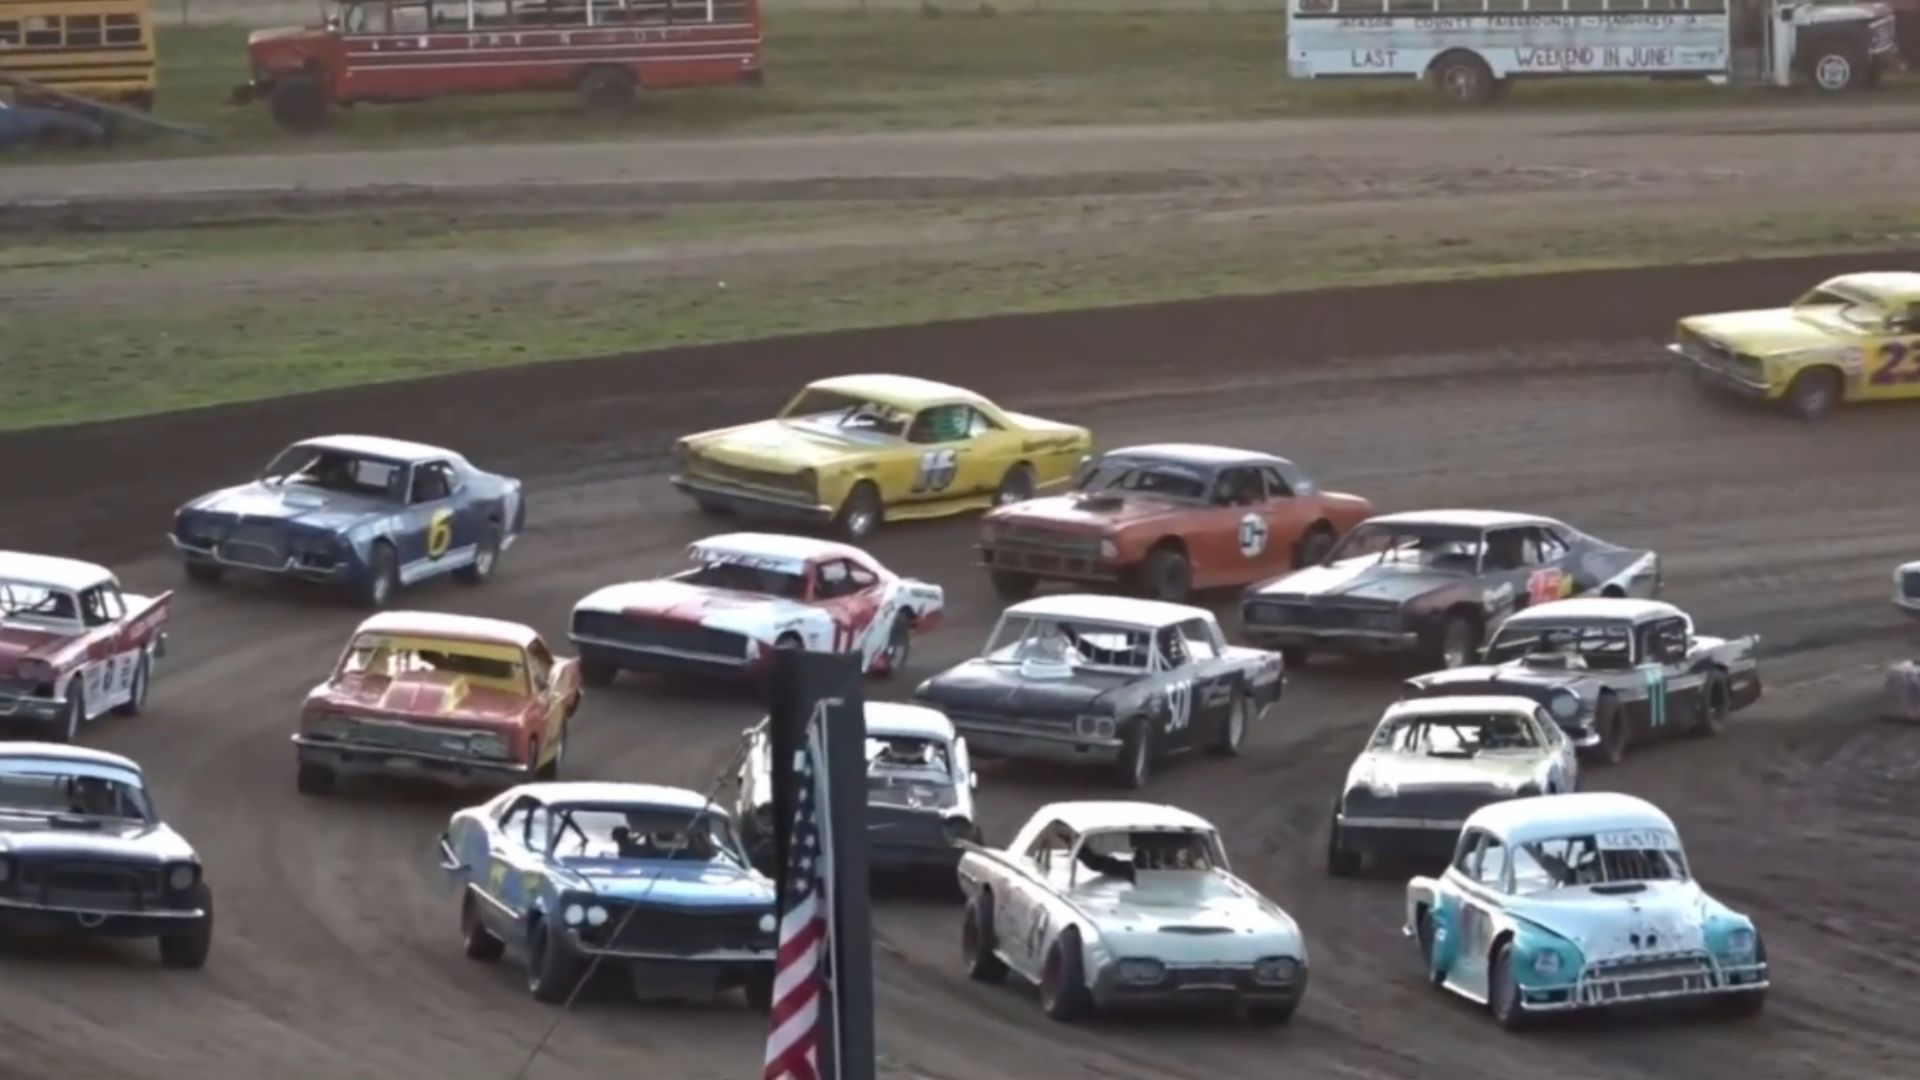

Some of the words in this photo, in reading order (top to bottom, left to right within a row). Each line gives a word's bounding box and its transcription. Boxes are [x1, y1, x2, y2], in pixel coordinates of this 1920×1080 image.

[1351, 49, 1398, 68] LAST
[1603, 49, 1620, 66] IN
[429, 506, 453, 559] 6
